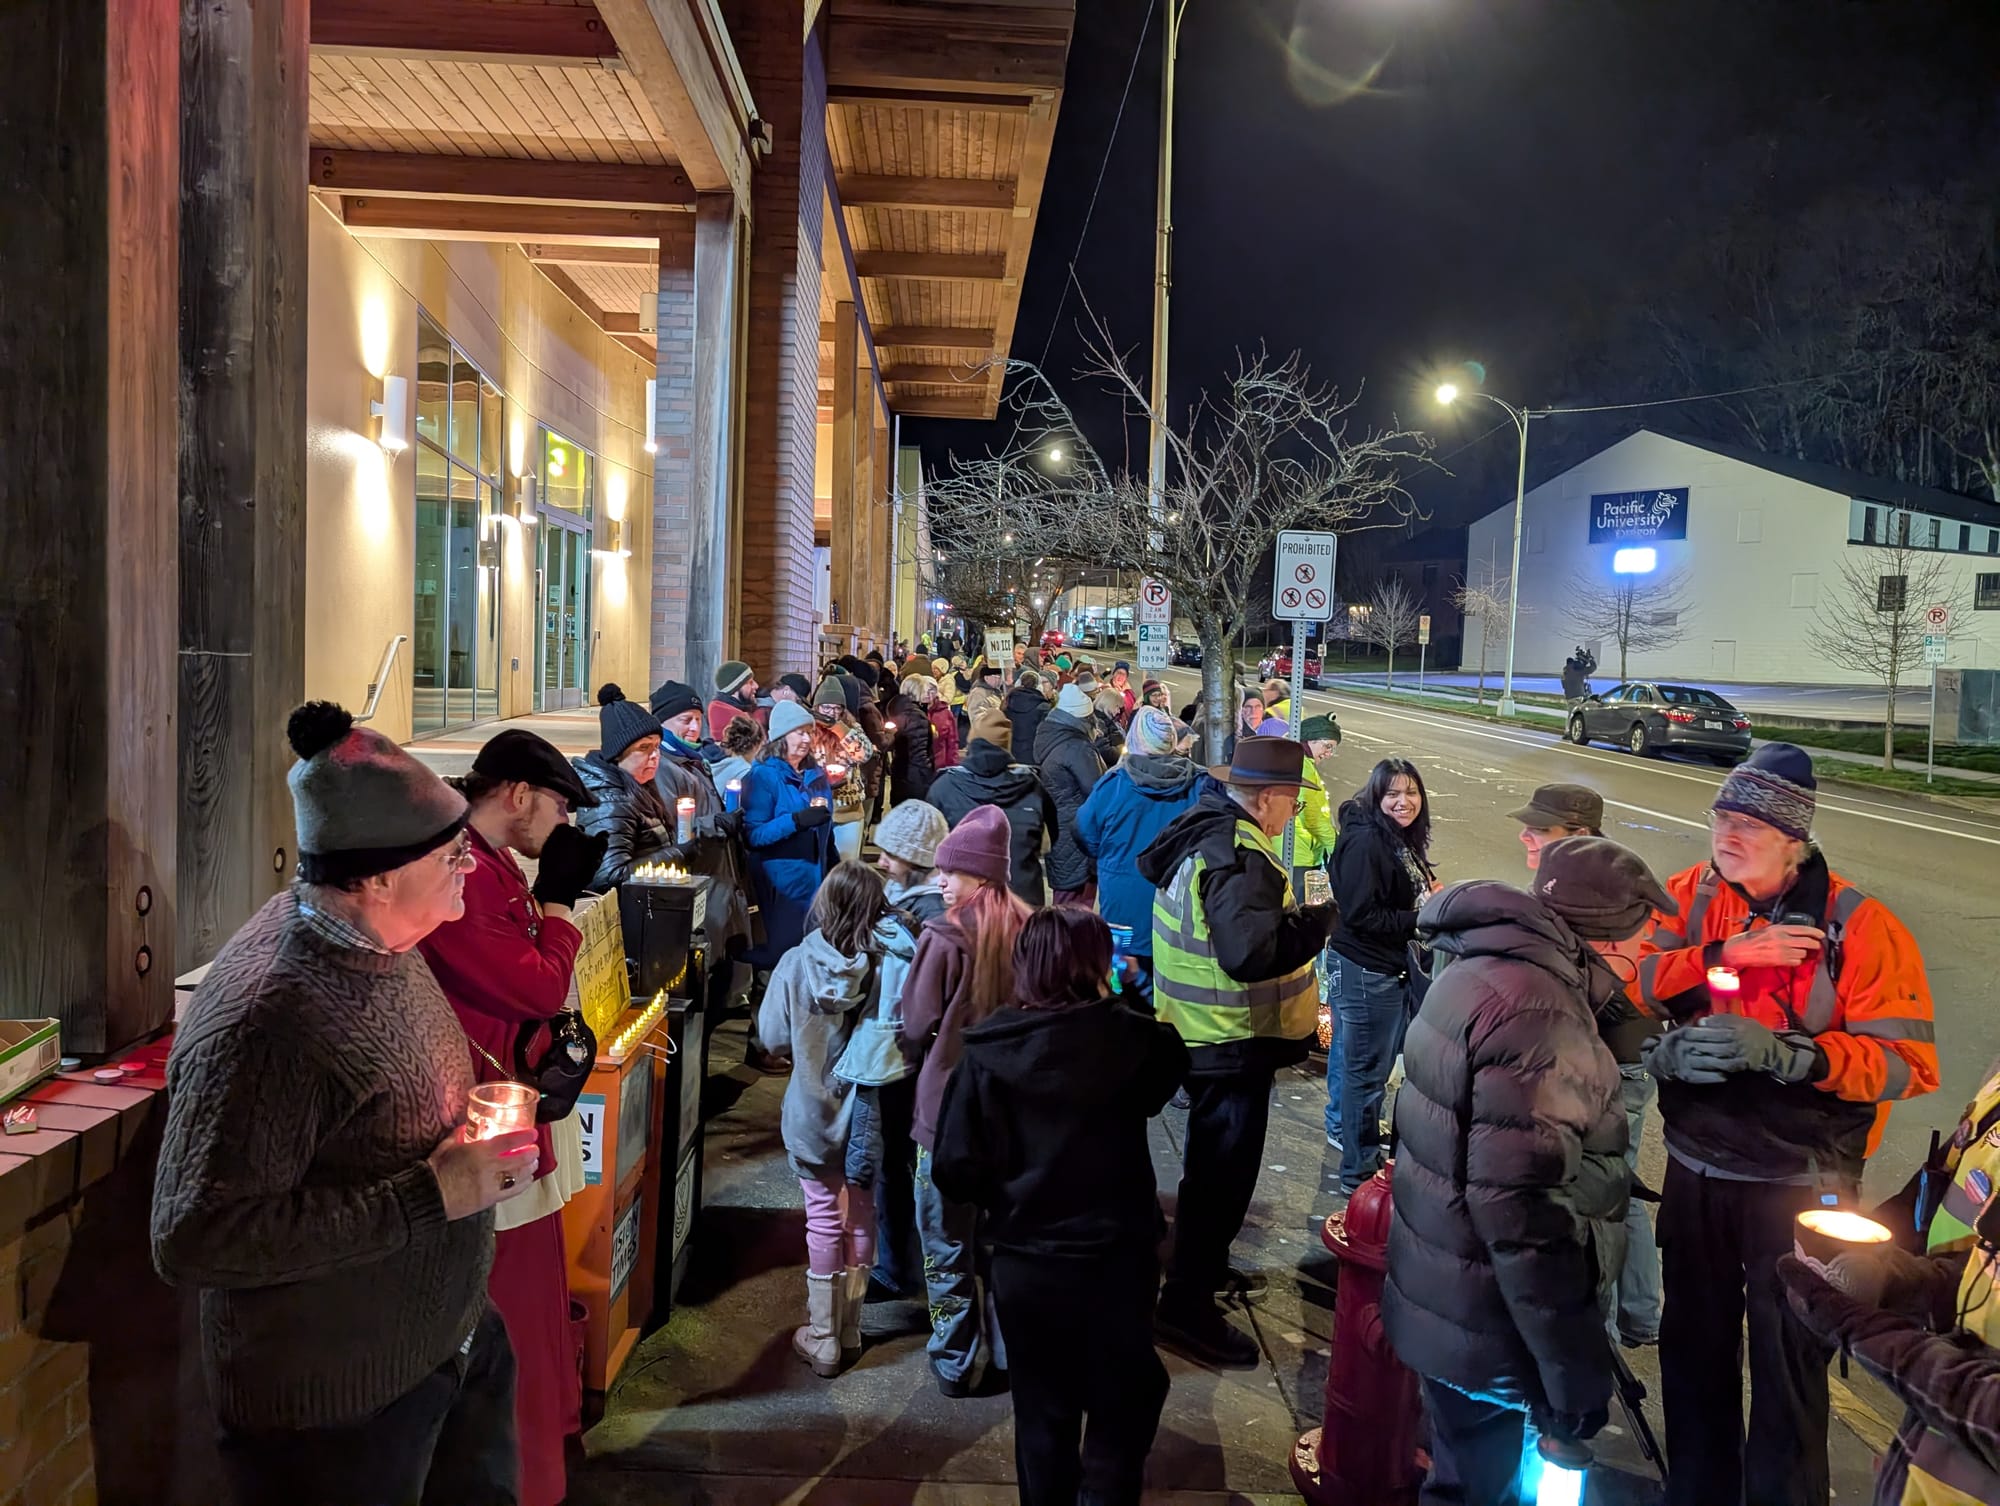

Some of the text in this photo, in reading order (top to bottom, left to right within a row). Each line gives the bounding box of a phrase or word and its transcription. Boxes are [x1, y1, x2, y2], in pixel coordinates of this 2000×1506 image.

[1603, 501, 1645, 515] Pacific
[1597, 513, 1665, 528] University
[1282, 543, 1332, 556] PROHIBITED
[1140, 627, 1147, 639] 2
[1001, 640, 1011, 651] ICE
[1926, 636, 1932, 645] 2
[611, 1232, 637, 1288] TIMES
